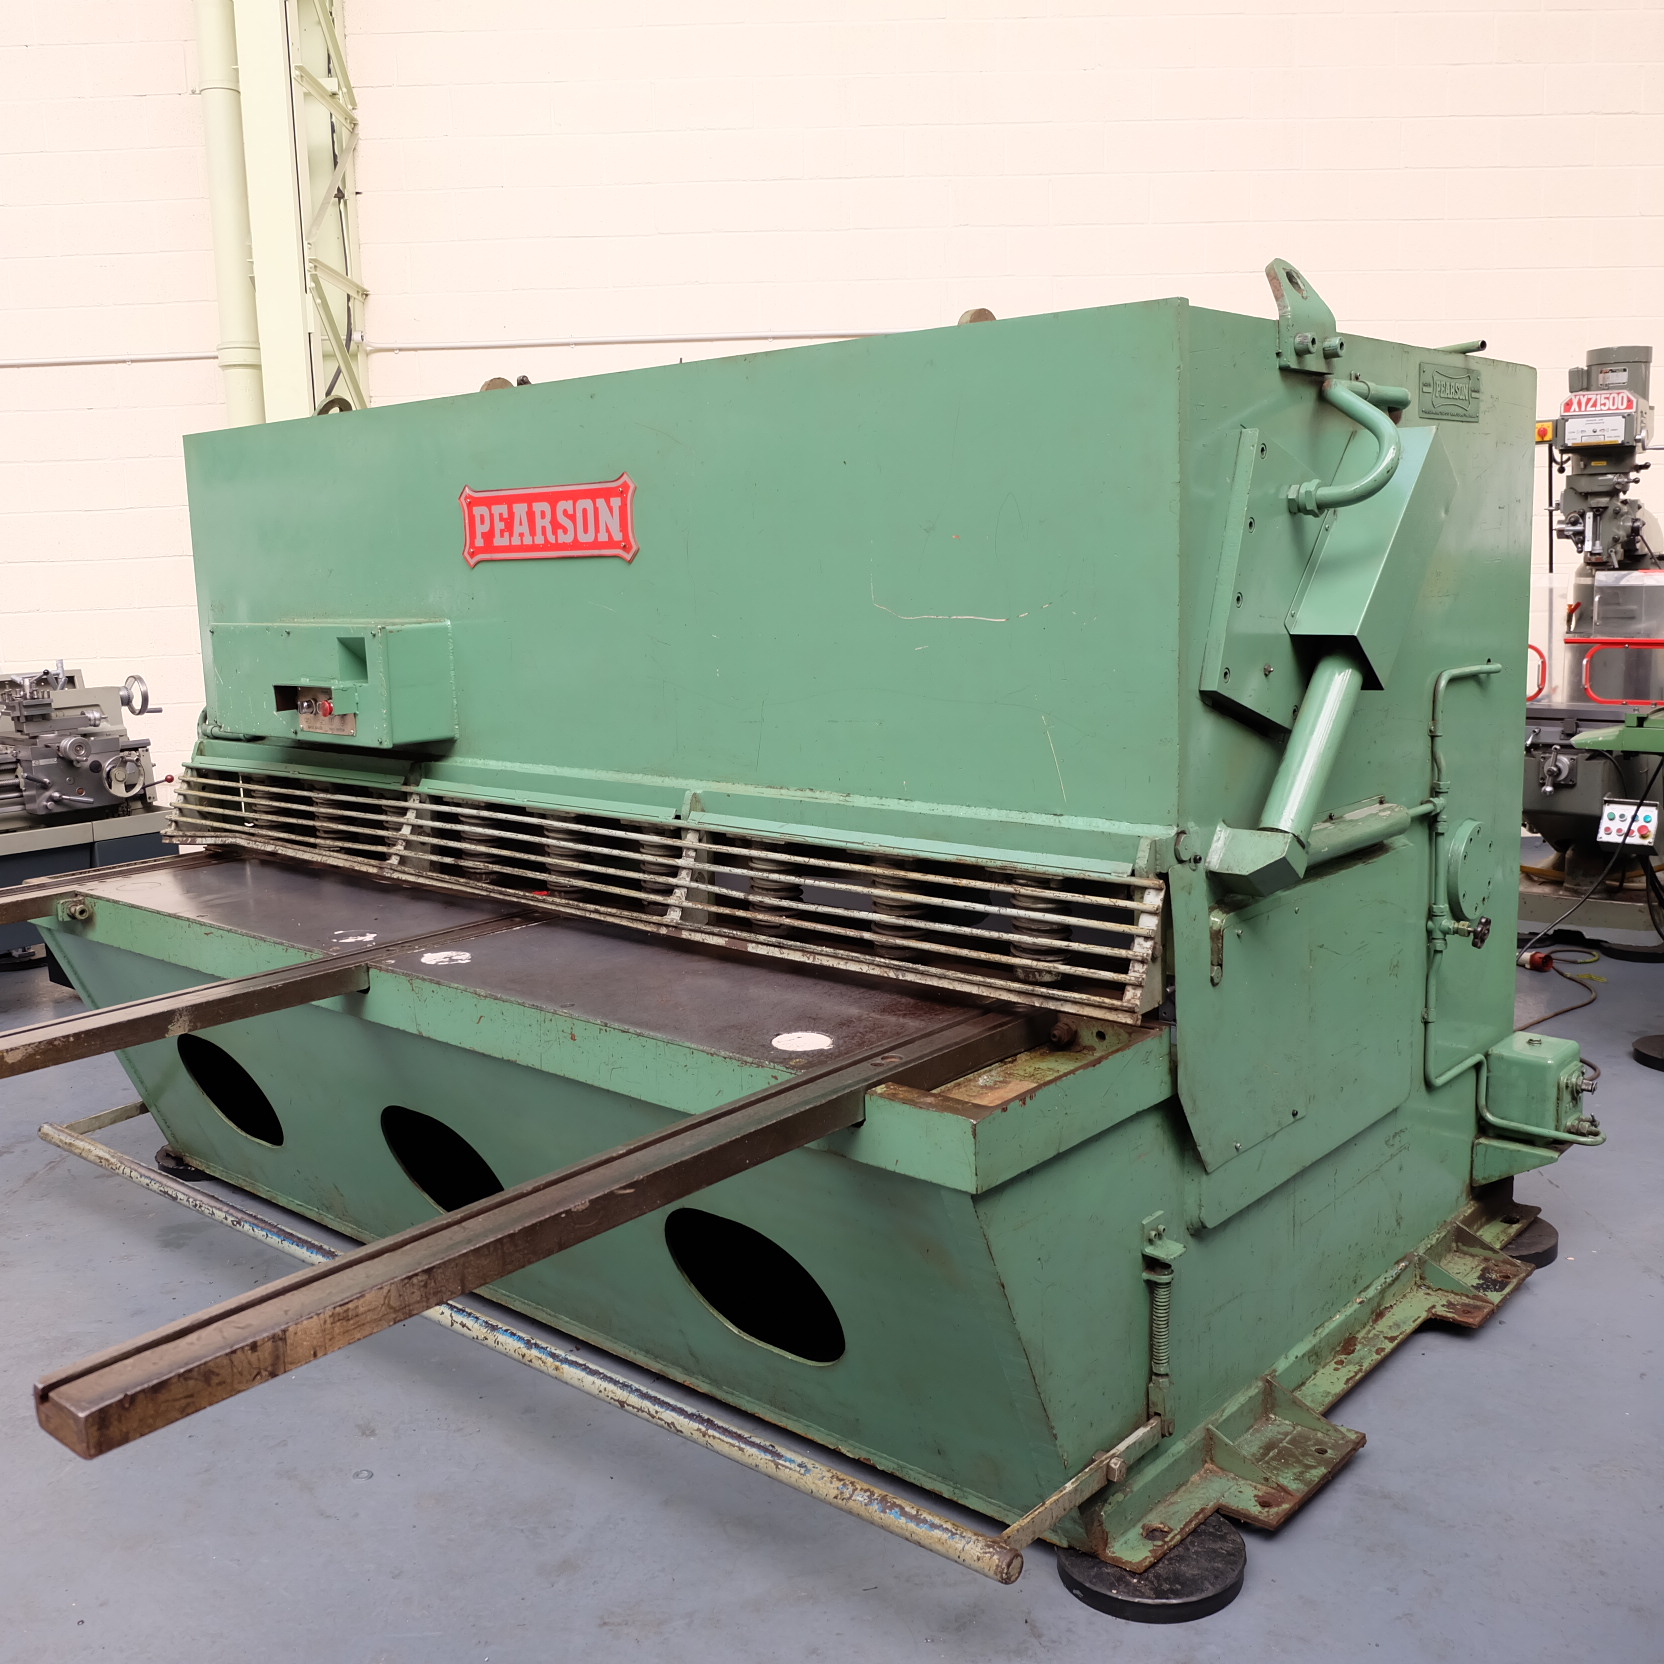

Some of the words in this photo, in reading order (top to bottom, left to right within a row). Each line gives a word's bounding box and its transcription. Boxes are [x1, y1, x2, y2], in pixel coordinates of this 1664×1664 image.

[1435, 380, 1468, 401] PEARSON
[1569, 393, 1627, 412] XYZ1500
[472, 497, 623, 547] PEARSON
